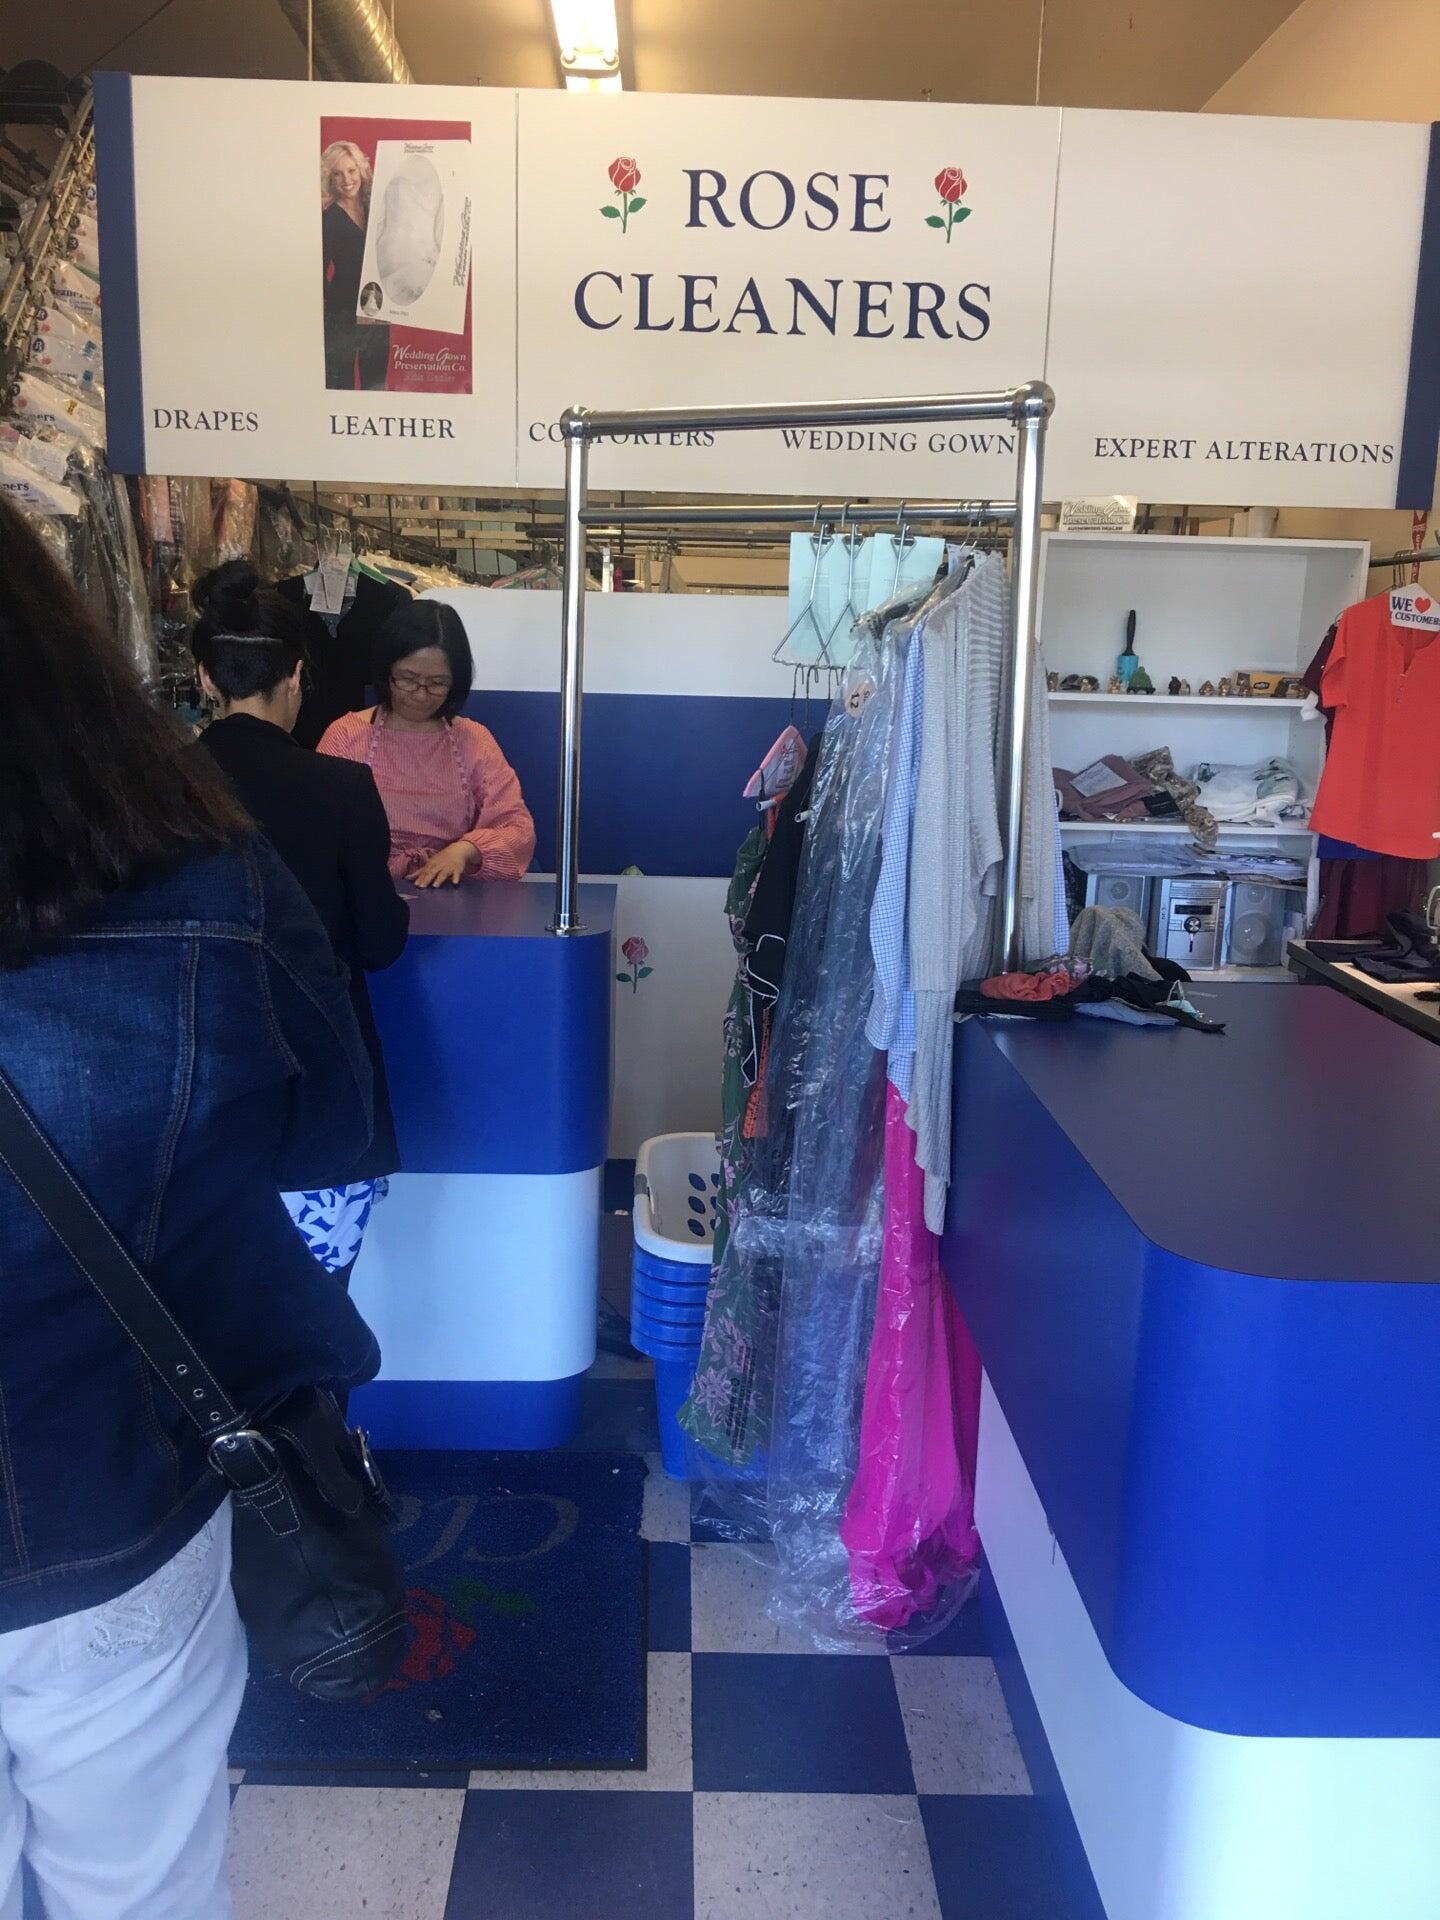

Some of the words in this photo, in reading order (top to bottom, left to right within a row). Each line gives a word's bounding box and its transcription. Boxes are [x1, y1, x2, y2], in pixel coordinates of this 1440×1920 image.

[682, 168, 892, 234] ROSE
[574, 270, 991, 342] CLEANERS
[392, 344, 434, 361] Wedding
[435, 347, 466, 366] Gown
[152, 408, 259, 432] DRAPES
[329, 415, 456, 439] LEATHER
[781, 429, 918, 453] WEDDING
[928, 433, 1017, 455] GOWN
[1094, 437, 1197, 459] EXPERT
[1205, 440, 1395, 463] ALTERATIONS
[1392, 596, 1414, 612] WE
[1394, 611, 1440, 626] CUSTOMER
